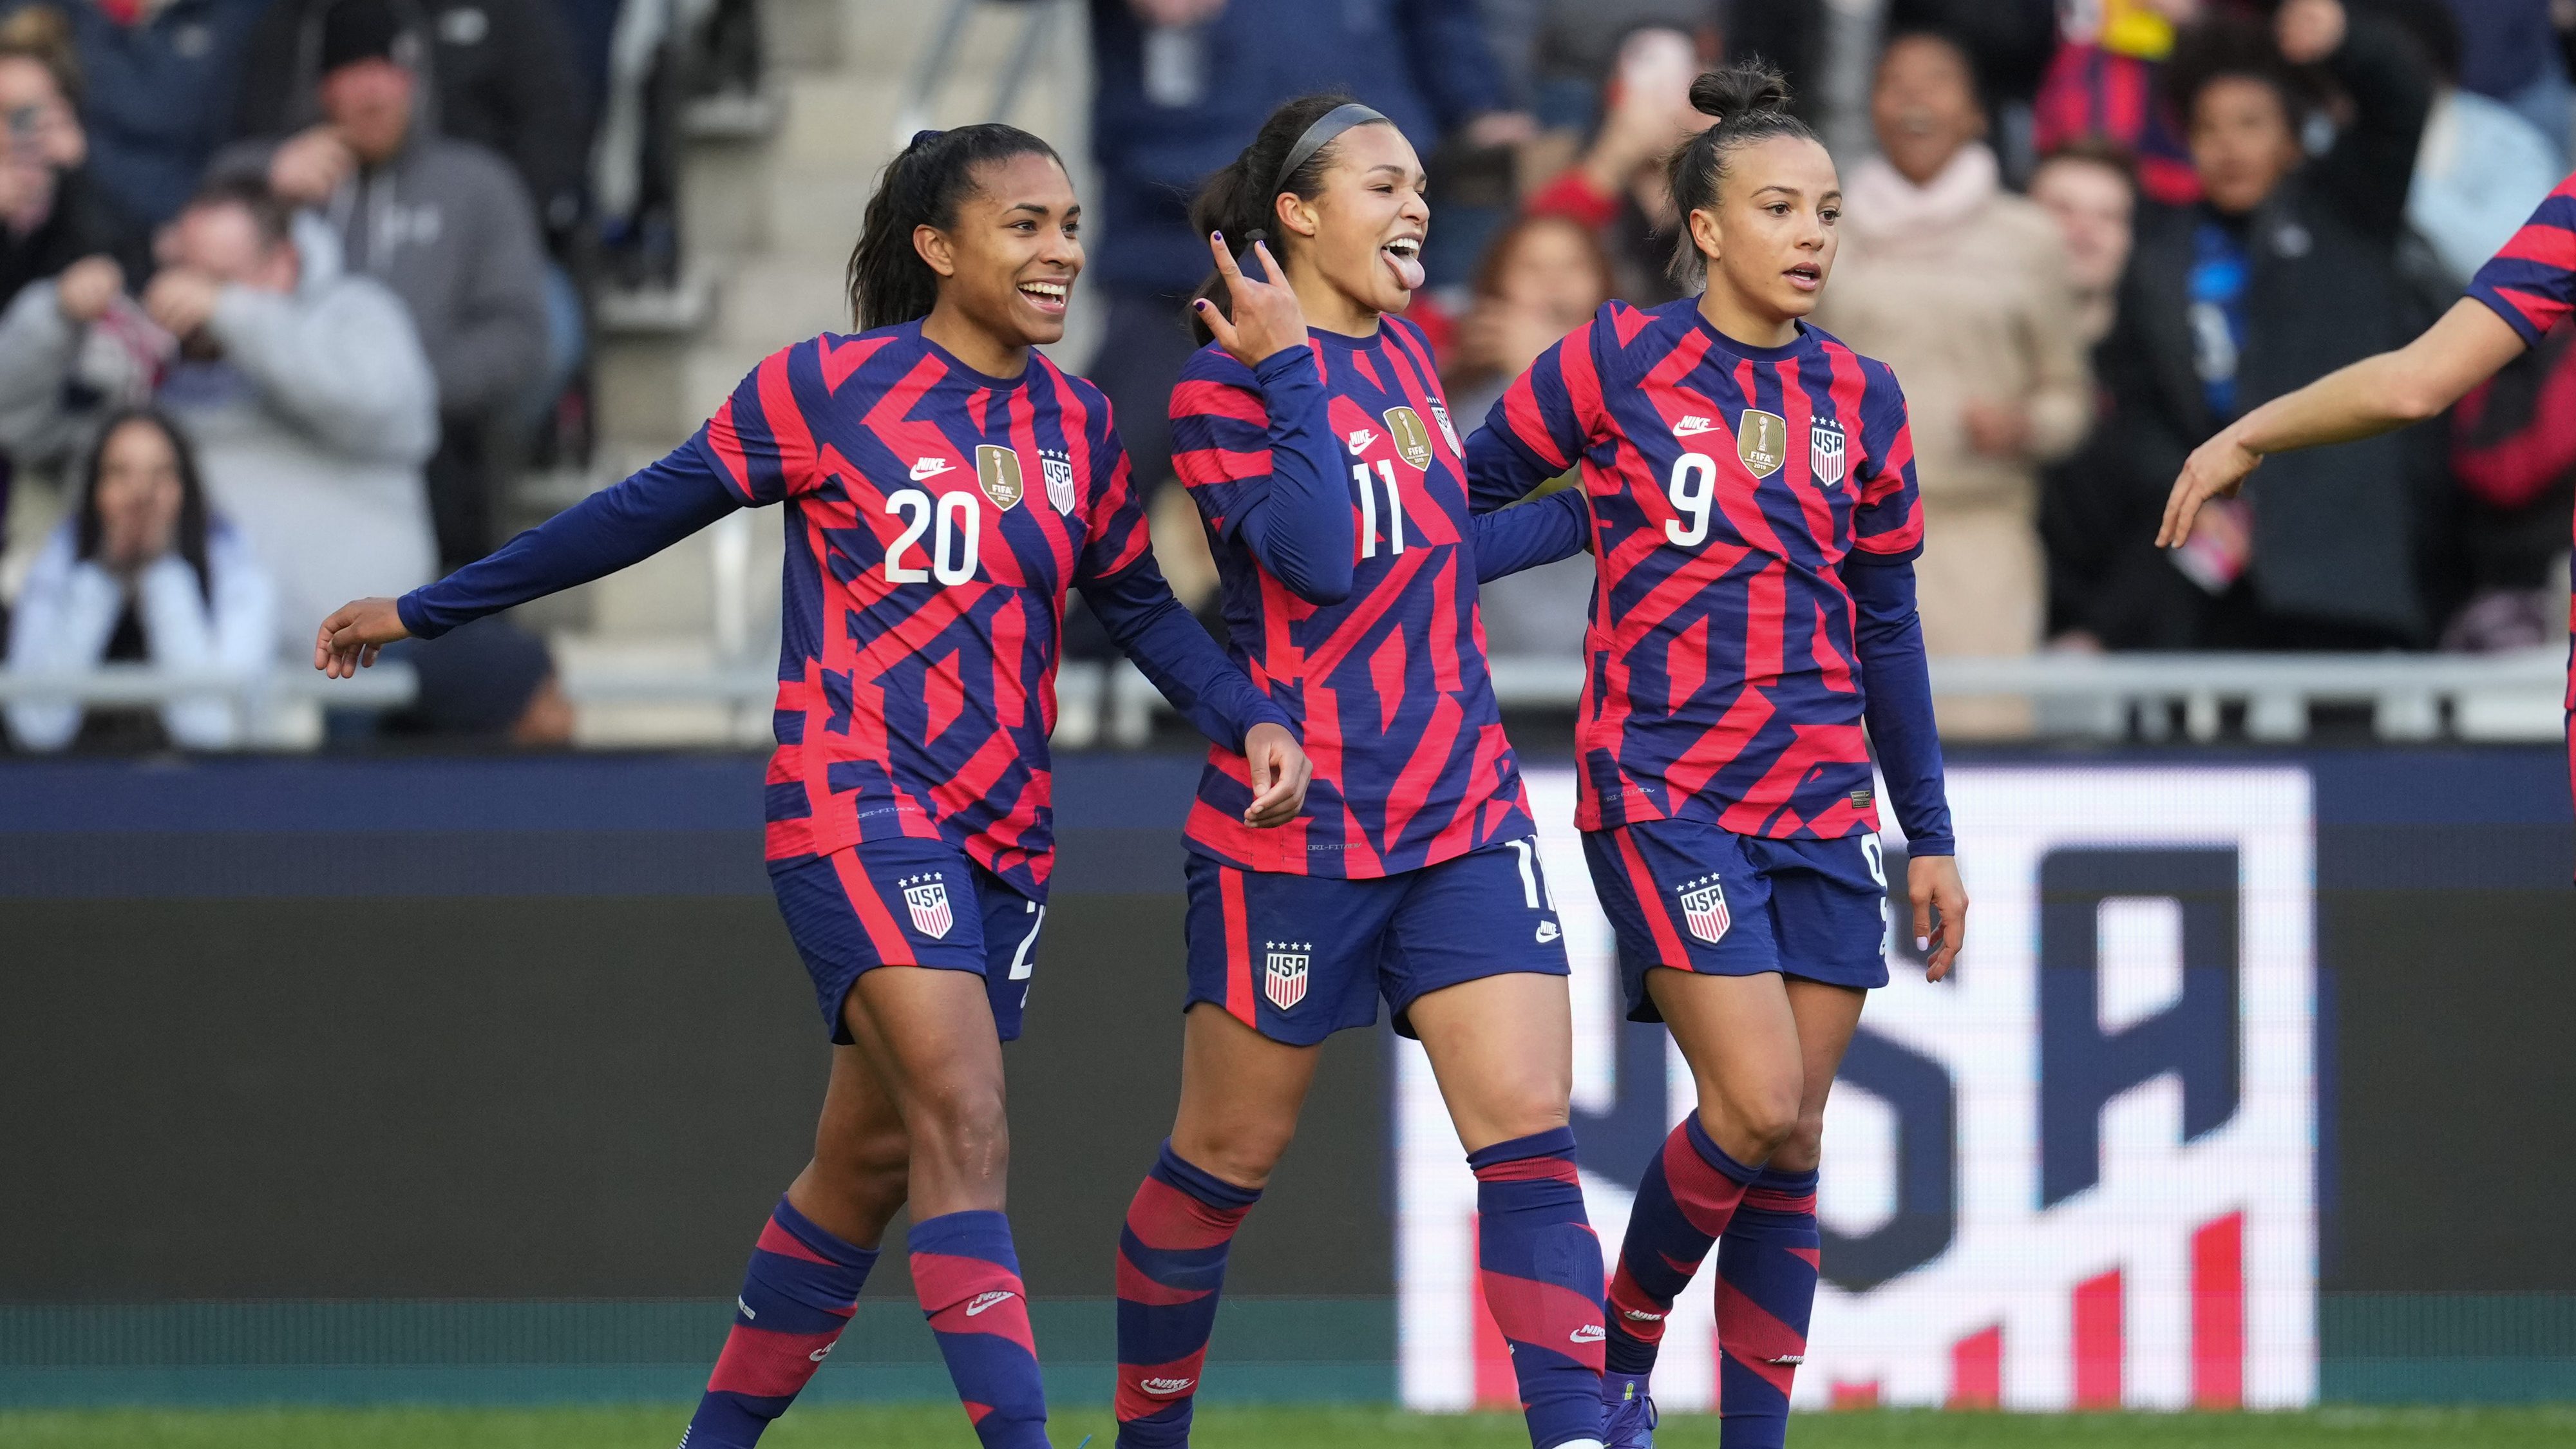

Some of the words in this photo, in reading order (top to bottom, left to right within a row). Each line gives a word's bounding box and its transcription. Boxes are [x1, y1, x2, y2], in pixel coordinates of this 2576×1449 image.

[1679, 415, 1711, 430] NIKE
[1349, 429, 1370, 445] NIKE
[1814, 430, 1842, 453] USA
[1408, 446, 1425, 456] FIFA
[1750, 451, 1771, 463] FIFA
[916, 457, 946, 471] NIKE
[1045, 462, 1070, 484] USA
[992, 484, 1013, 495] FIFA
[1352, 459, 1404, 558] 11
[1665, 453, 1717, 546] 9
[885, 489, 980, 586] 20
[907, 886, 944, 908] USA
[1683, 887, 1721, 913] USA
[1540, 920, 1557, 934] NIKE
[1269, 956, 1306, 978] USA
[1150, 1377, 1189, 1390] NIKE
